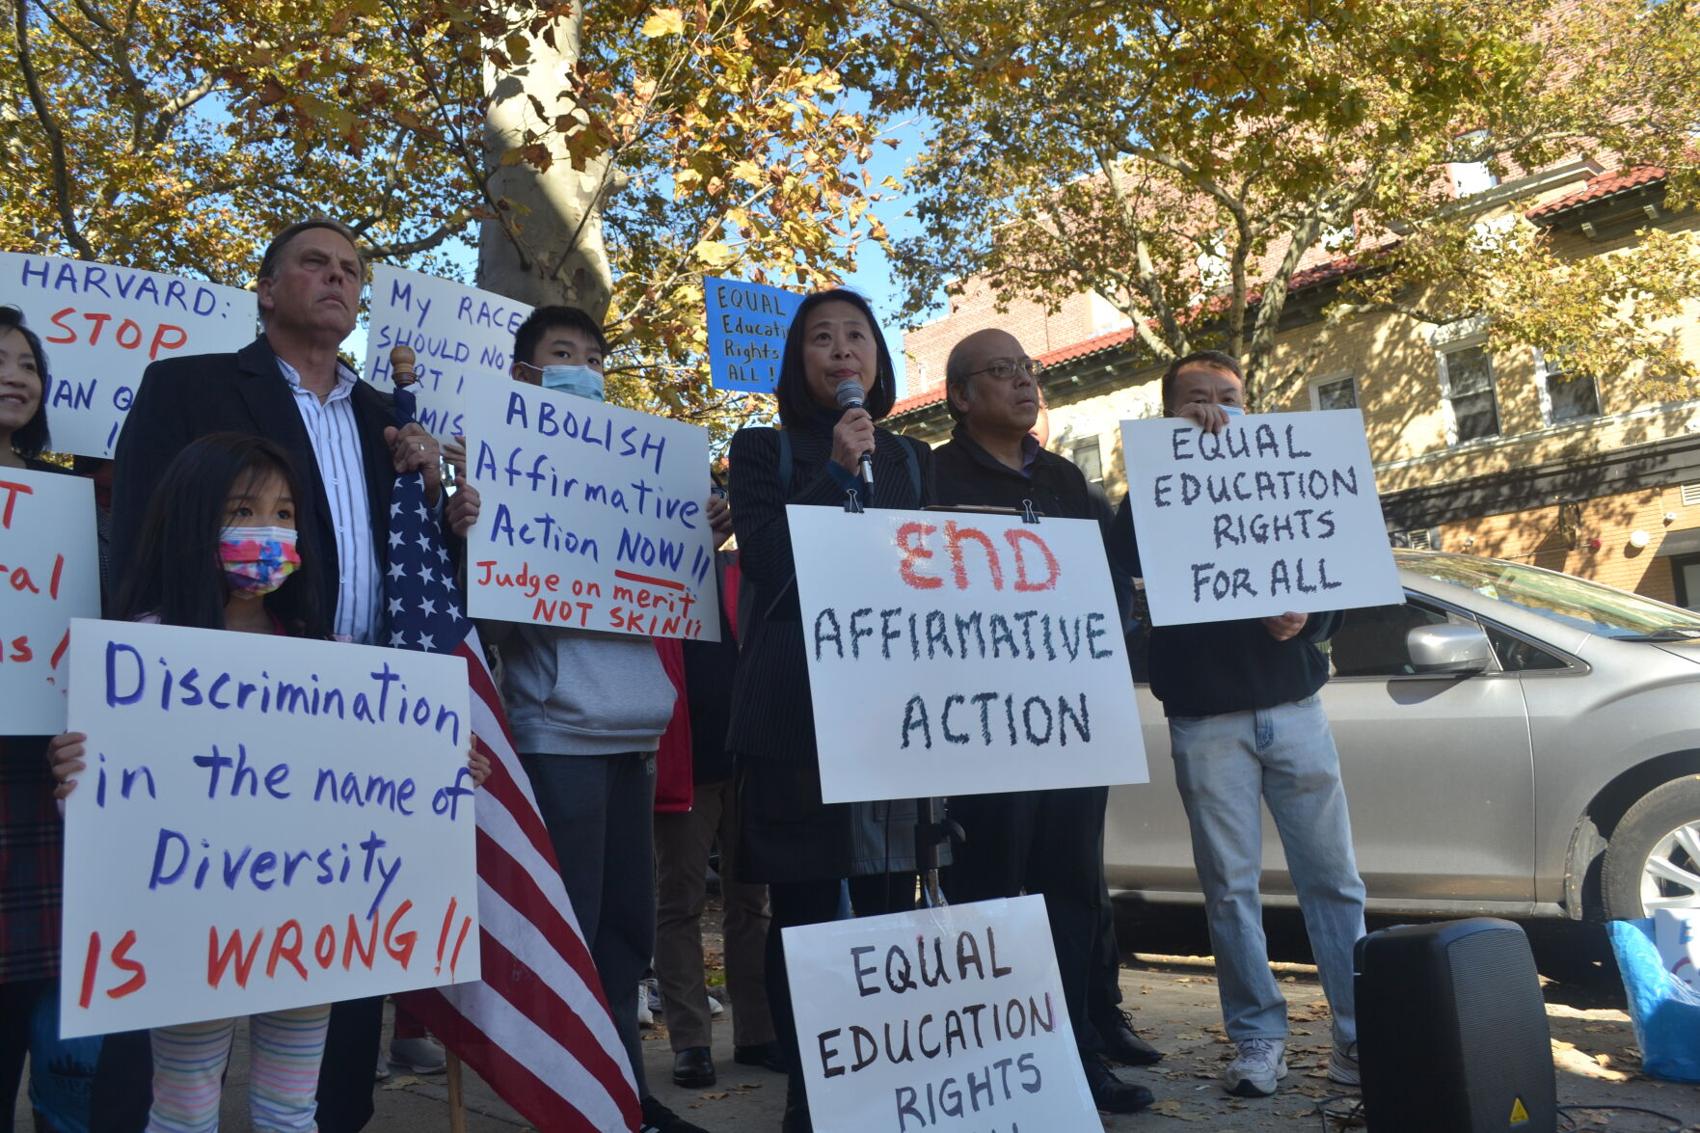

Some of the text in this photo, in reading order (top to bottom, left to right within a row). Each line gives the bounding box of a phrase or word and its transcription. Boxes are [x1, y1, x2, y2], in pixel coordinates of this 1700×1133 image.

[22, 259, 231, 319] HARVARD:
[717, 286, 786, 316] EQUAL
[46, 307, 188, 361] STOP
[457, 296, 523, 335] RACE
[722, 314, 789, 339] Educati
[377, 325, 470, 363] SHOULD
[725, 339, 780, 364] Rights
[43, 373, 97, 411] IAN
[371, 356, 443, 391] HRT
[729, 364, 760, 382] ALL
[506, 391, 666, 474] ABOLISH
[1172, 423, 1312, 461] EQUAL
[475, 439, 700, 529] Affirmative
[1154, 465, 1358, 508] EDUCATION
[490, 503, 600, 563] Action
[1213, 508, 1336, 549] RIGHTS
[0, 553, 65, 601] al
[476, 560, 560, 598] Judge
[571, 579, 601, 598] on
[1191, 557, 1342, 602] FOR ALL
[532, 598, 593, 627] NOT
[813, 607, 1114, 663] AFFIRMATIVE
[105, 640, 460, 746] Discrimination
[900, 691, 1092, 750] ACTION
[96, 743, 475, 821] in the name of
[148, 828, 402, 921] Diversity
[78, 929, 147, 1010] IS
[850, 926, 1013, 998] EQUAL
[816, 992, 1057, 1079] EDUCATION
[894, 1052, 1043, 1133] RIGHTS
